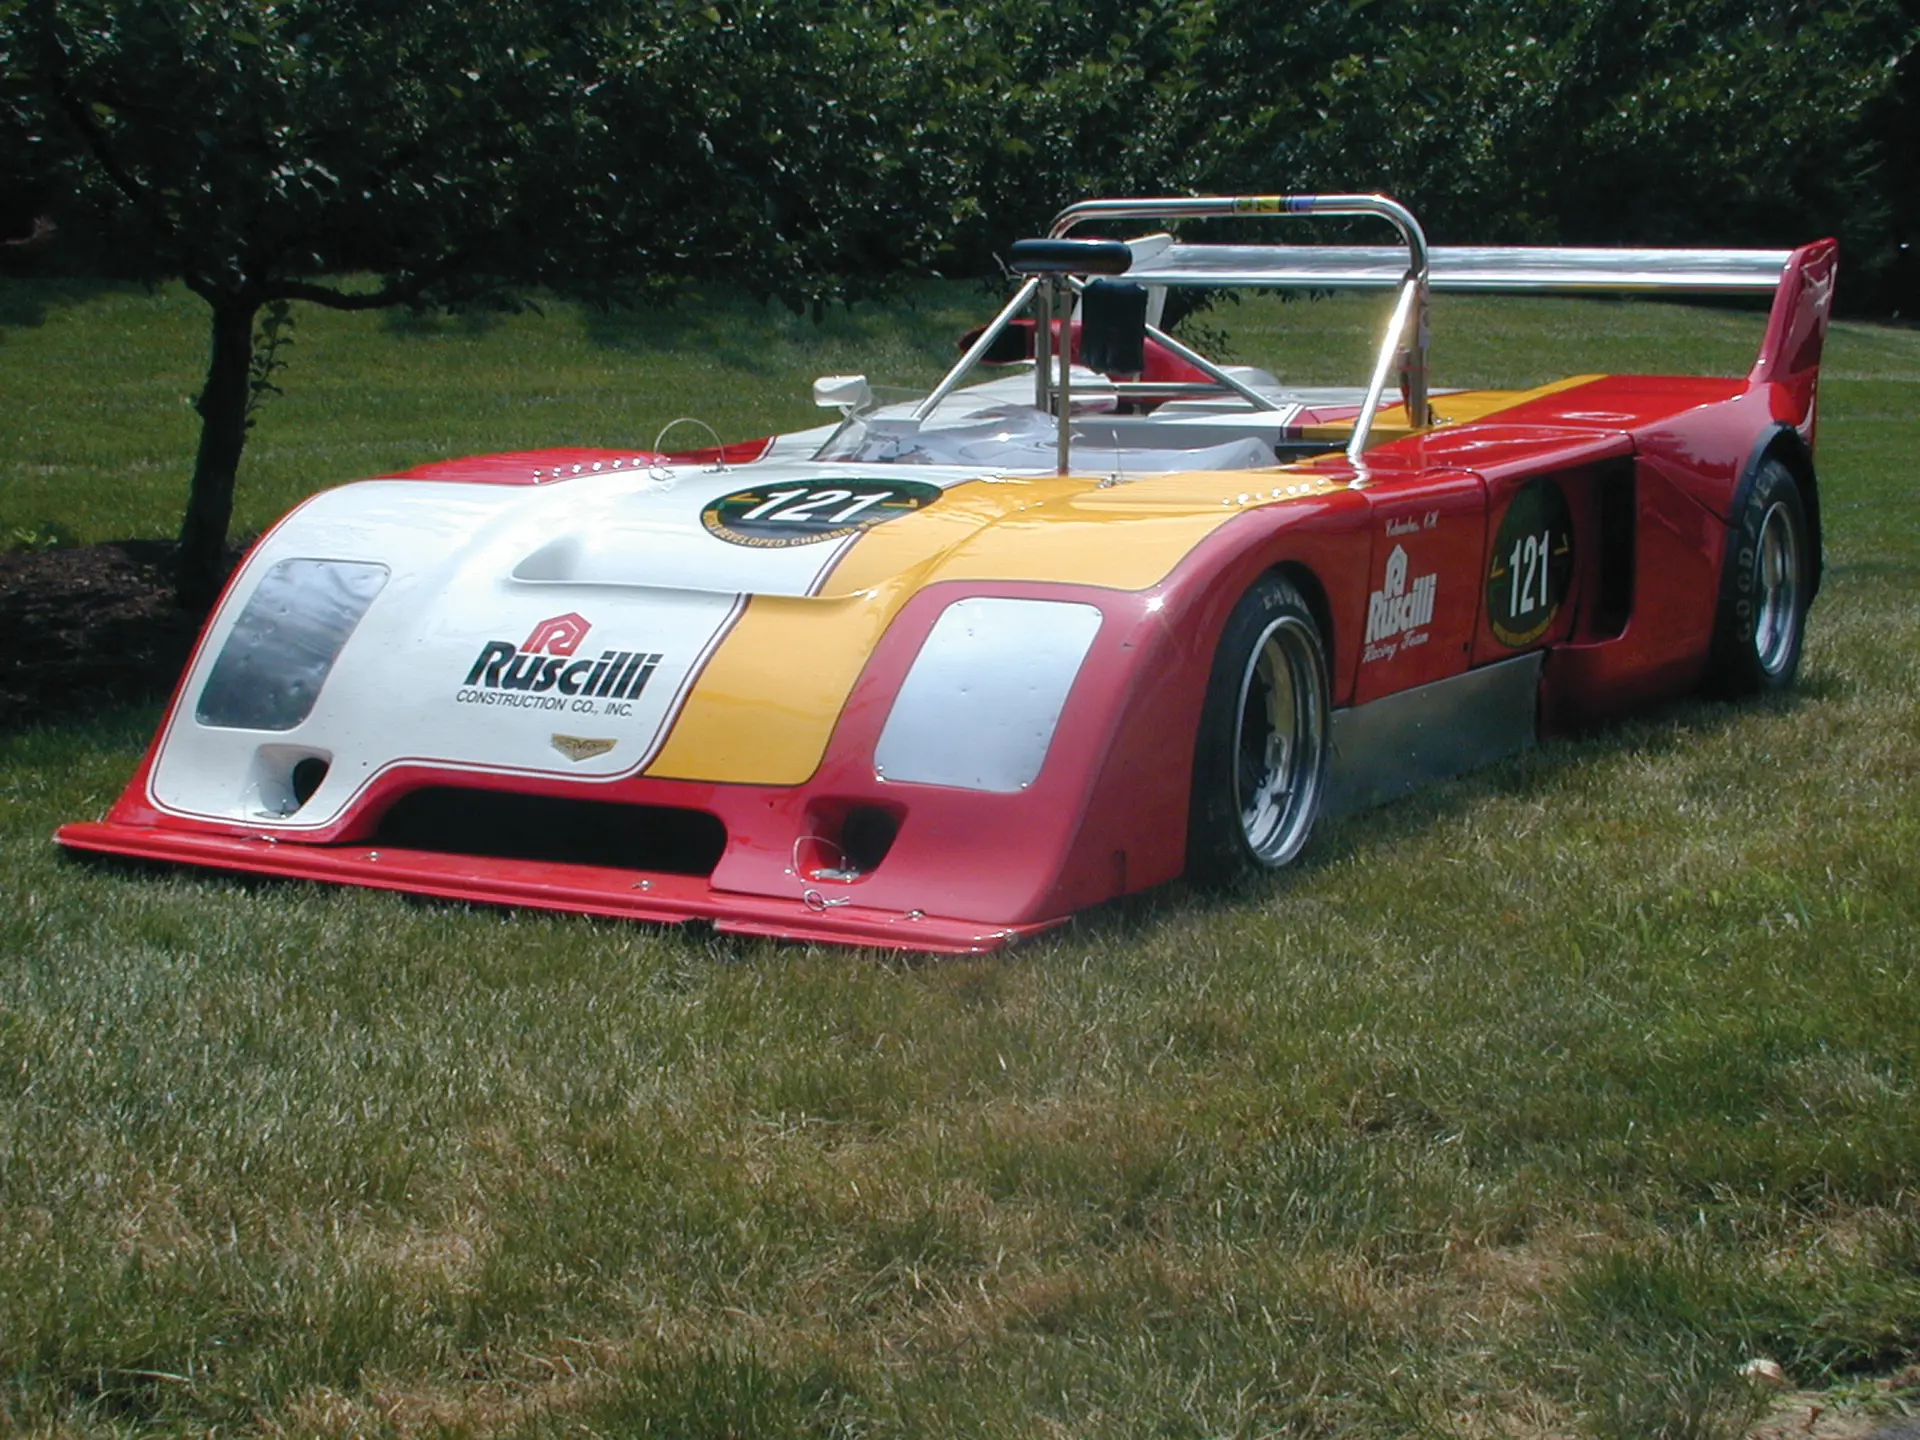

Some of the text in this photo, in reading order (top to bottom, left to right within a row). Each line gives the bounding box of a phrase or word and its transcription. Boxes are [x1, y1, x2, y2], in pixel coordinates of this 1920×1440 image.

[741, 488, 894, 523] 121
[790, 527, 855, 546] CHASSIS
[1509, 529, 1550, 618] 121
[1364, 573, 1437, 645] Ruscilli
[1401, 630, 1429, 649] Team
[463, 640, 664, 700] Ruscilli
[456, 689, 568, 711] CONSTRUCTION
[604, 703, 633, 717] INC.
